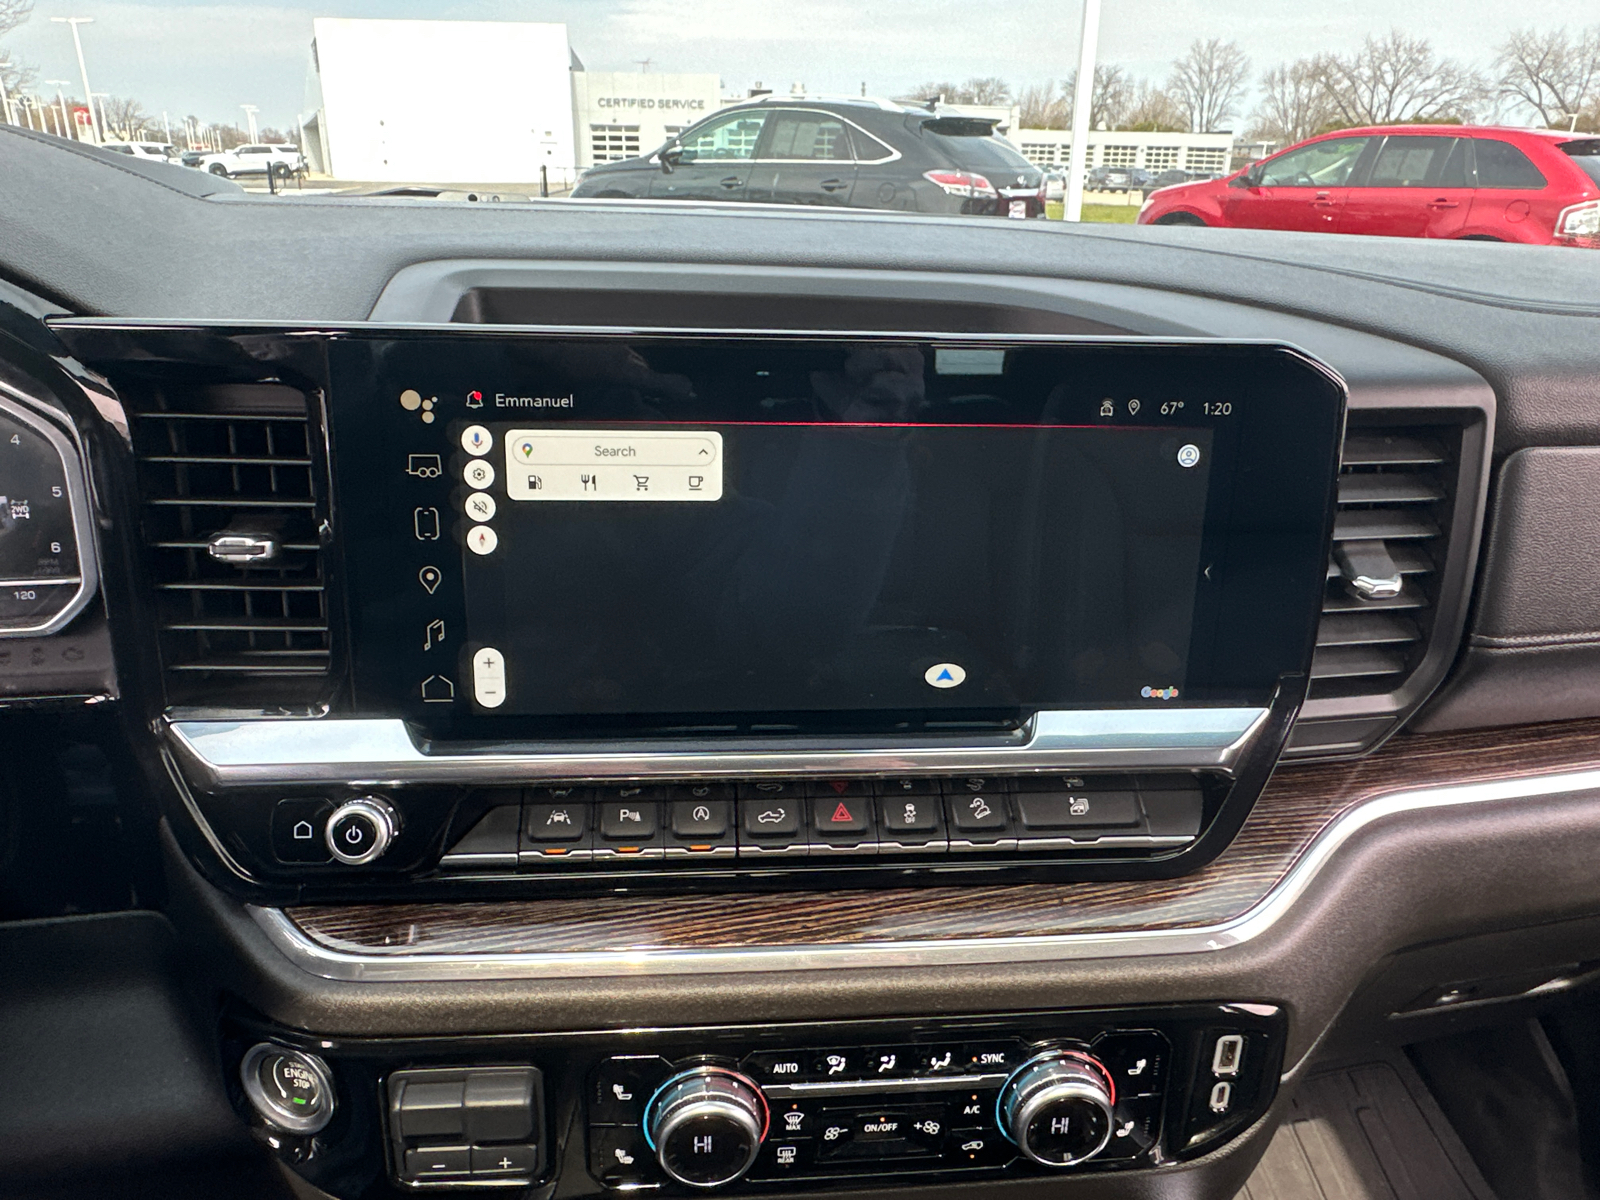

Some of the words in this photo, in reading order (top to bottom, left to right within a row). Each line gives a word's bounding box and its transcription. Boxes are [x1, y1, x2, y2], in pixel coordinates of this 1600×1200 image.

[598, 97, 655, 109] CERTIFIED
[657, 99, 705, 110] SERVICE
[495, 393, 574, 408] Emmanuel
[1203, 402, 1232, 415] 1:20
[10, 434, 20, 445] 4
[594, 445, 636, 457] Search
[52, 486, 62, 498] 5
[11, 505, 30, 514] 2WD
[51, 542, 61, 553] 6
[14, 591, 36, 600] 120
[1141, 686, 1178, 700] Google
[981, 1053, 1005, 1064] SYNC
[773, 1063, 798, 1073] AUTO
[964, 1105, 980, 1115] A/C
[864, 1123, 898, 1132] ON/OFF
[1051, 1117, 1069, 1134] HI
[693, 1136, 712, 1153] HI
